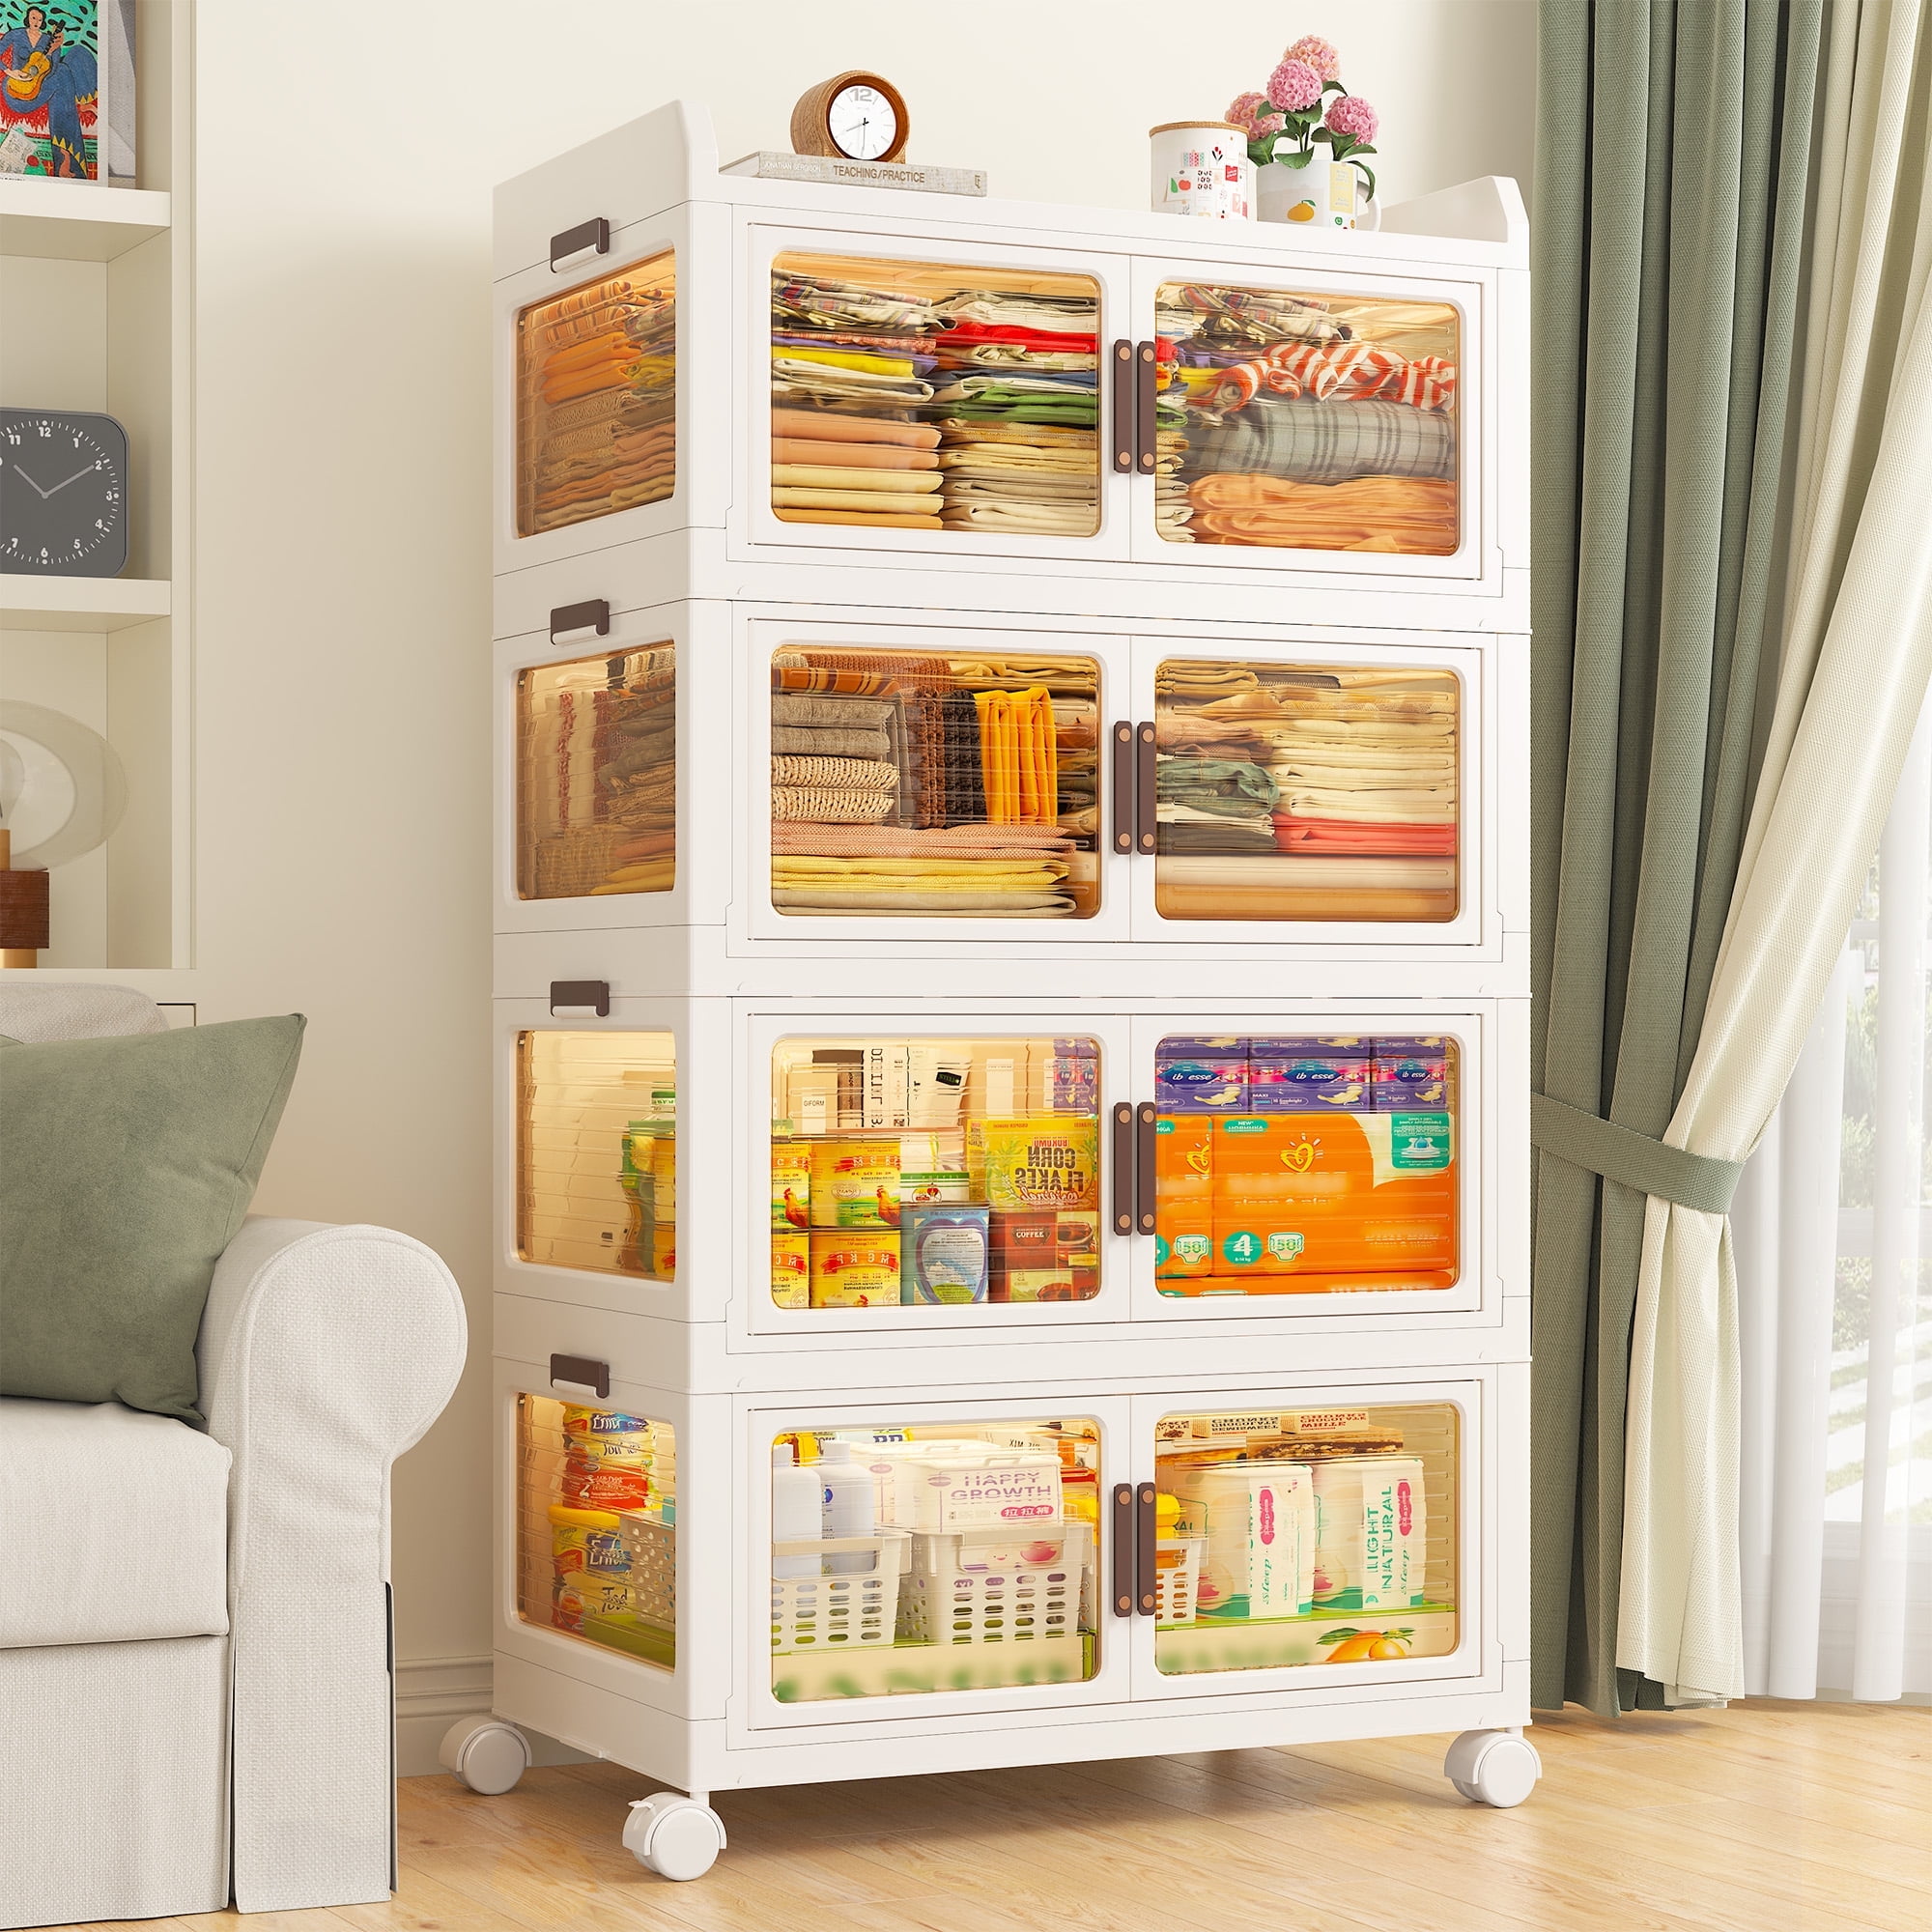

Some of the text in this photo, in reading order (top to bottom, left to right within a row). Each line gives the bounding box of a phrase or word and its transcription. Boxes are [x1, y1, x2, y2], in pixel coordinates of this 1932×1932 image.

[849, 88, 872, 101] 12
[834, 165, 924, 183] TEACHING/PRACTICE
[39, 427, 51, 437] 12
[9, 435, 21, 445] 11
[72, 438, 79, 448] 1
[95, 460, 102, 470] 2
[106, 491, 113, 501] 3
[95, 519, 103, 528] 4
[12, 537, 18, 548] 7
[73, 539, 81, 549] 5
[41, 548, 48, 557] 6
[1233, 1234, 1253, 1256] 4
[965, 1472, 1040, 1487] HAPPY
[951, 1486, 1051, 1500] GROWTH
[1366, 1506, 1379, 1573] LIGHT
[1381, 1486, 1394, 1594] NATURAL
[1262, 1558, 1272, 1605] Sleep
